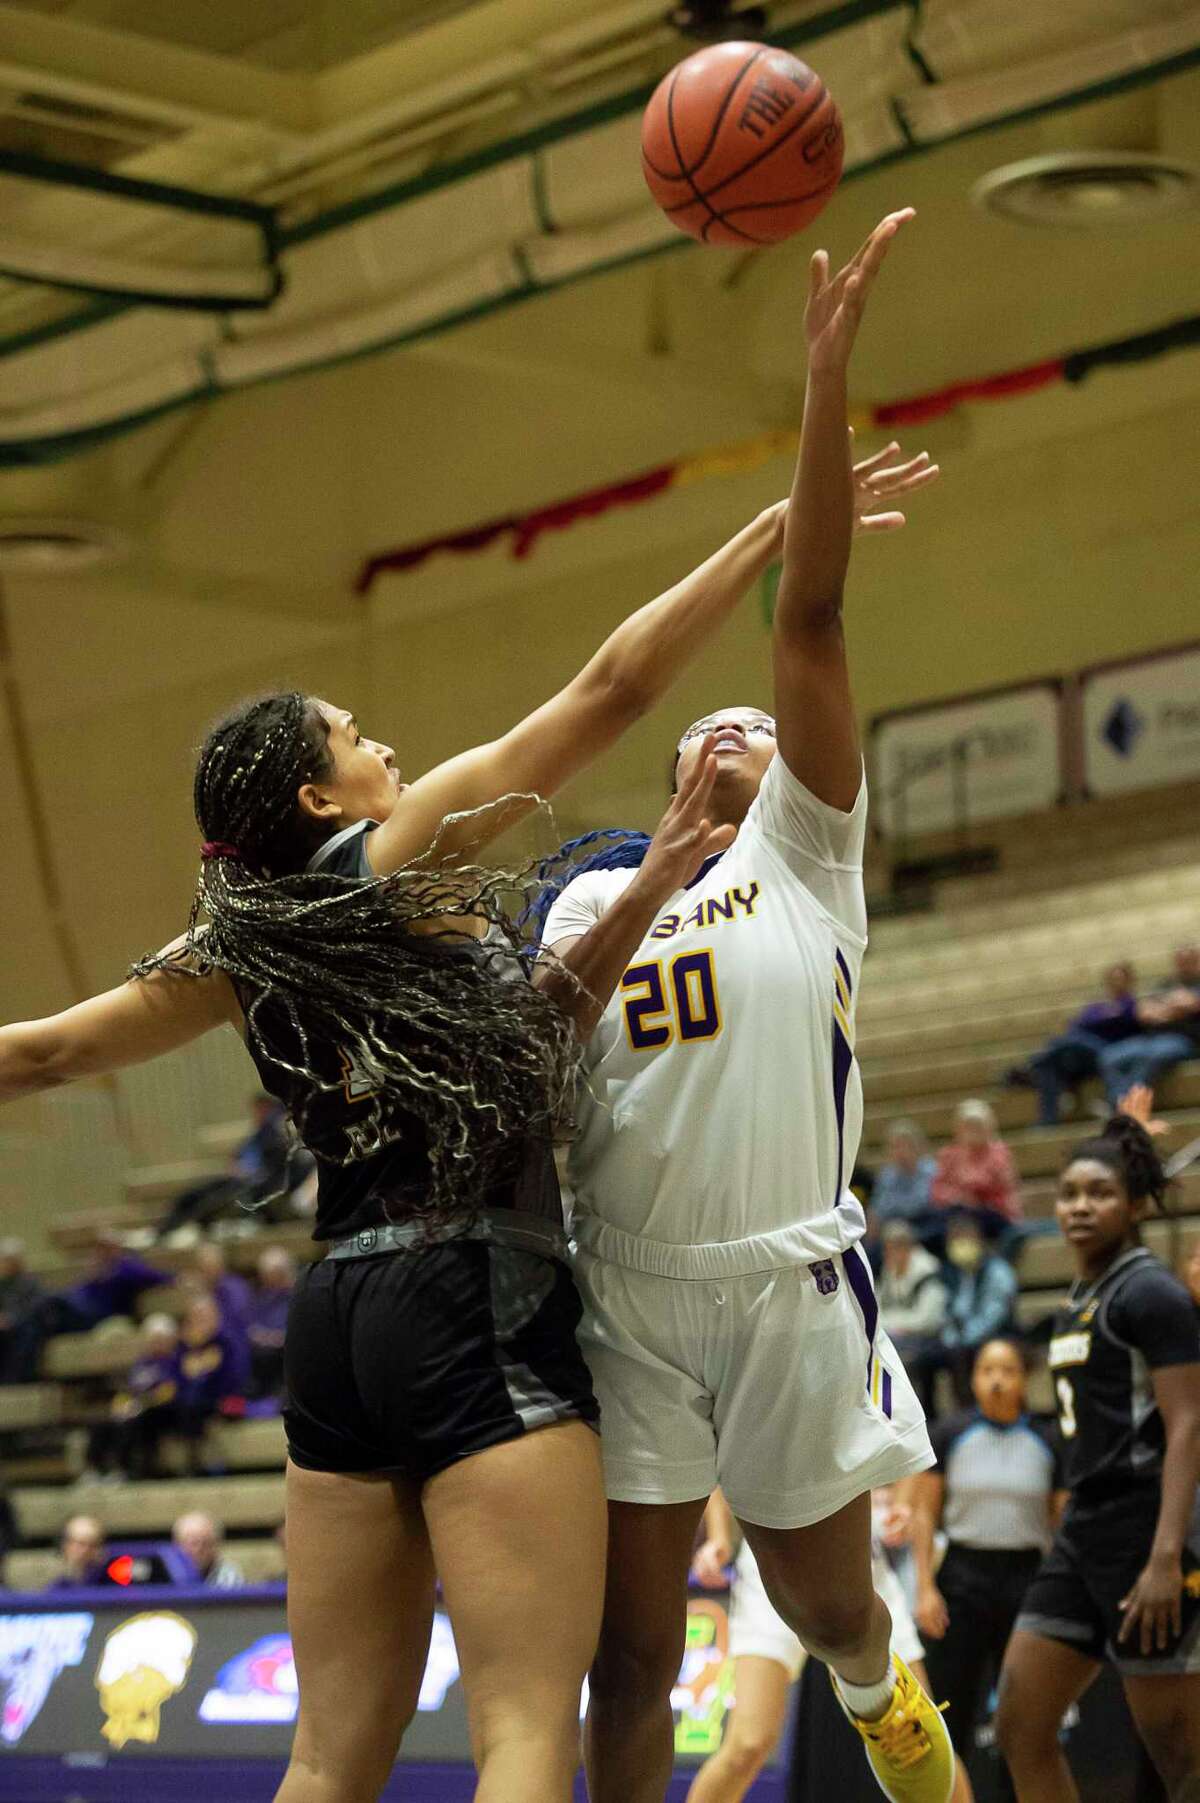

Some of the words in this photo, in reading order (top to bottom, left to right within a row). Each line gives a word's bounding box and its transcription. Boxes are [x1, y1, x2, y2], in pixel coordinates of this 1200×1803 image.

[739, 78, 796, 138] THE
[649, 880, 762, 940] BANY
[620, 947, 724, 1053] 20
